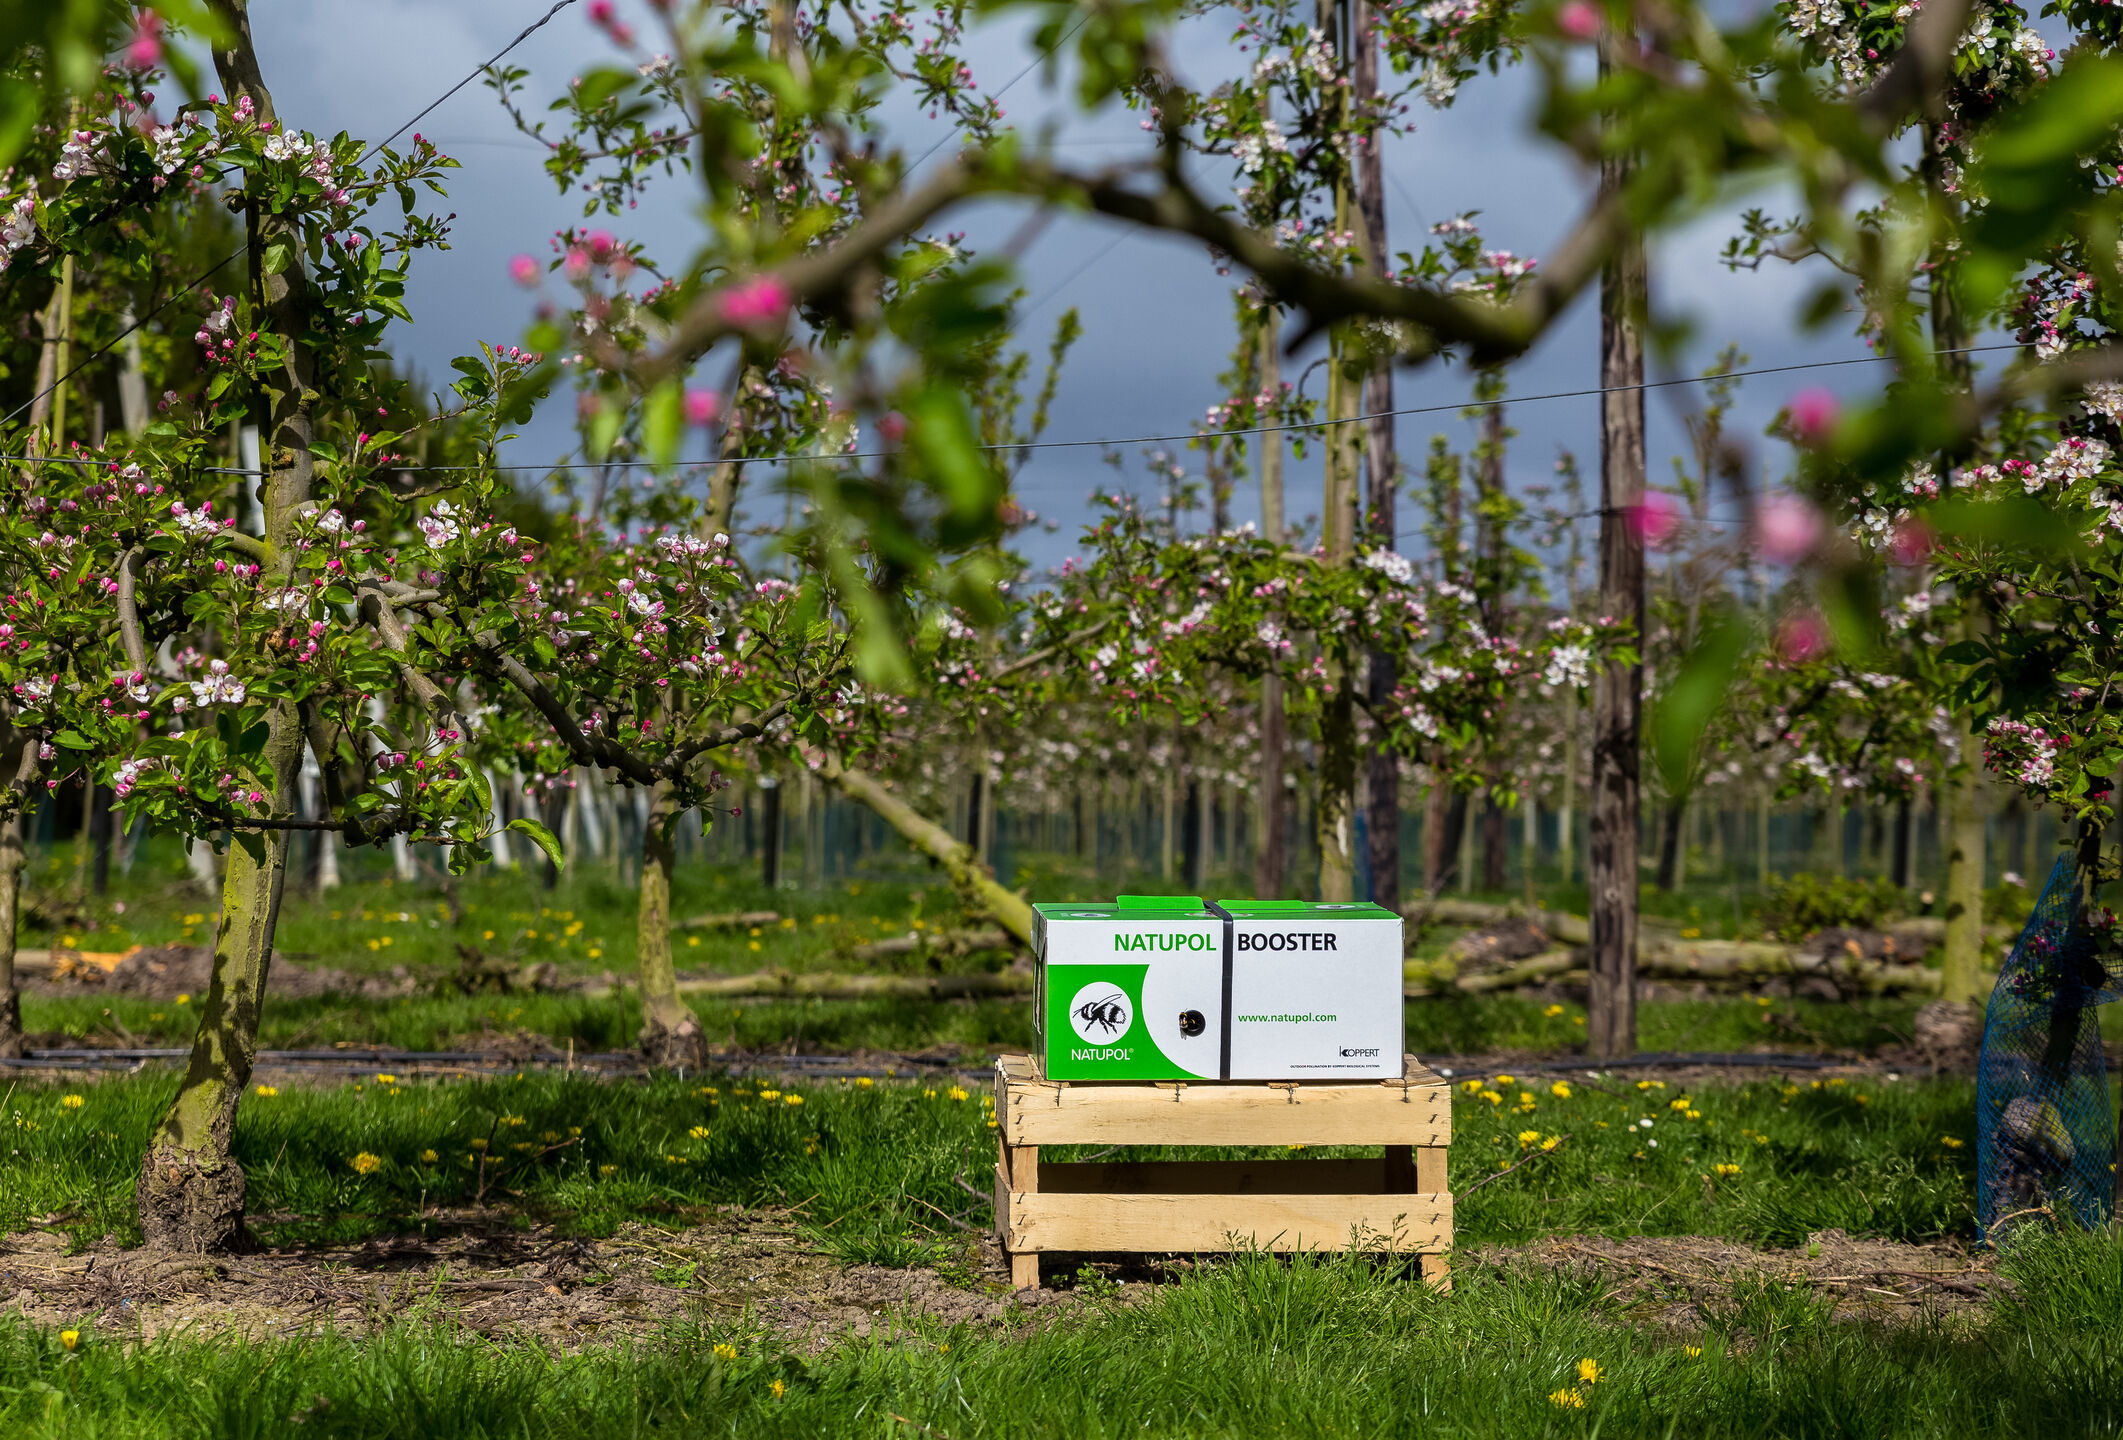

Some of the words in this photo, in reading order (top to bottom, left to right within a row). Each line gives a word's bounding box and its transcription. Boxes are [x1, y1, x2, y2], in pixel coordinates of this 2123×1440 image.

[1114, 933, 1217, 952] NATUPOL
[1237, 933, 1338, 952] BOOSTER
[1237, 1012, 1337, 1024] www.natupol.com
